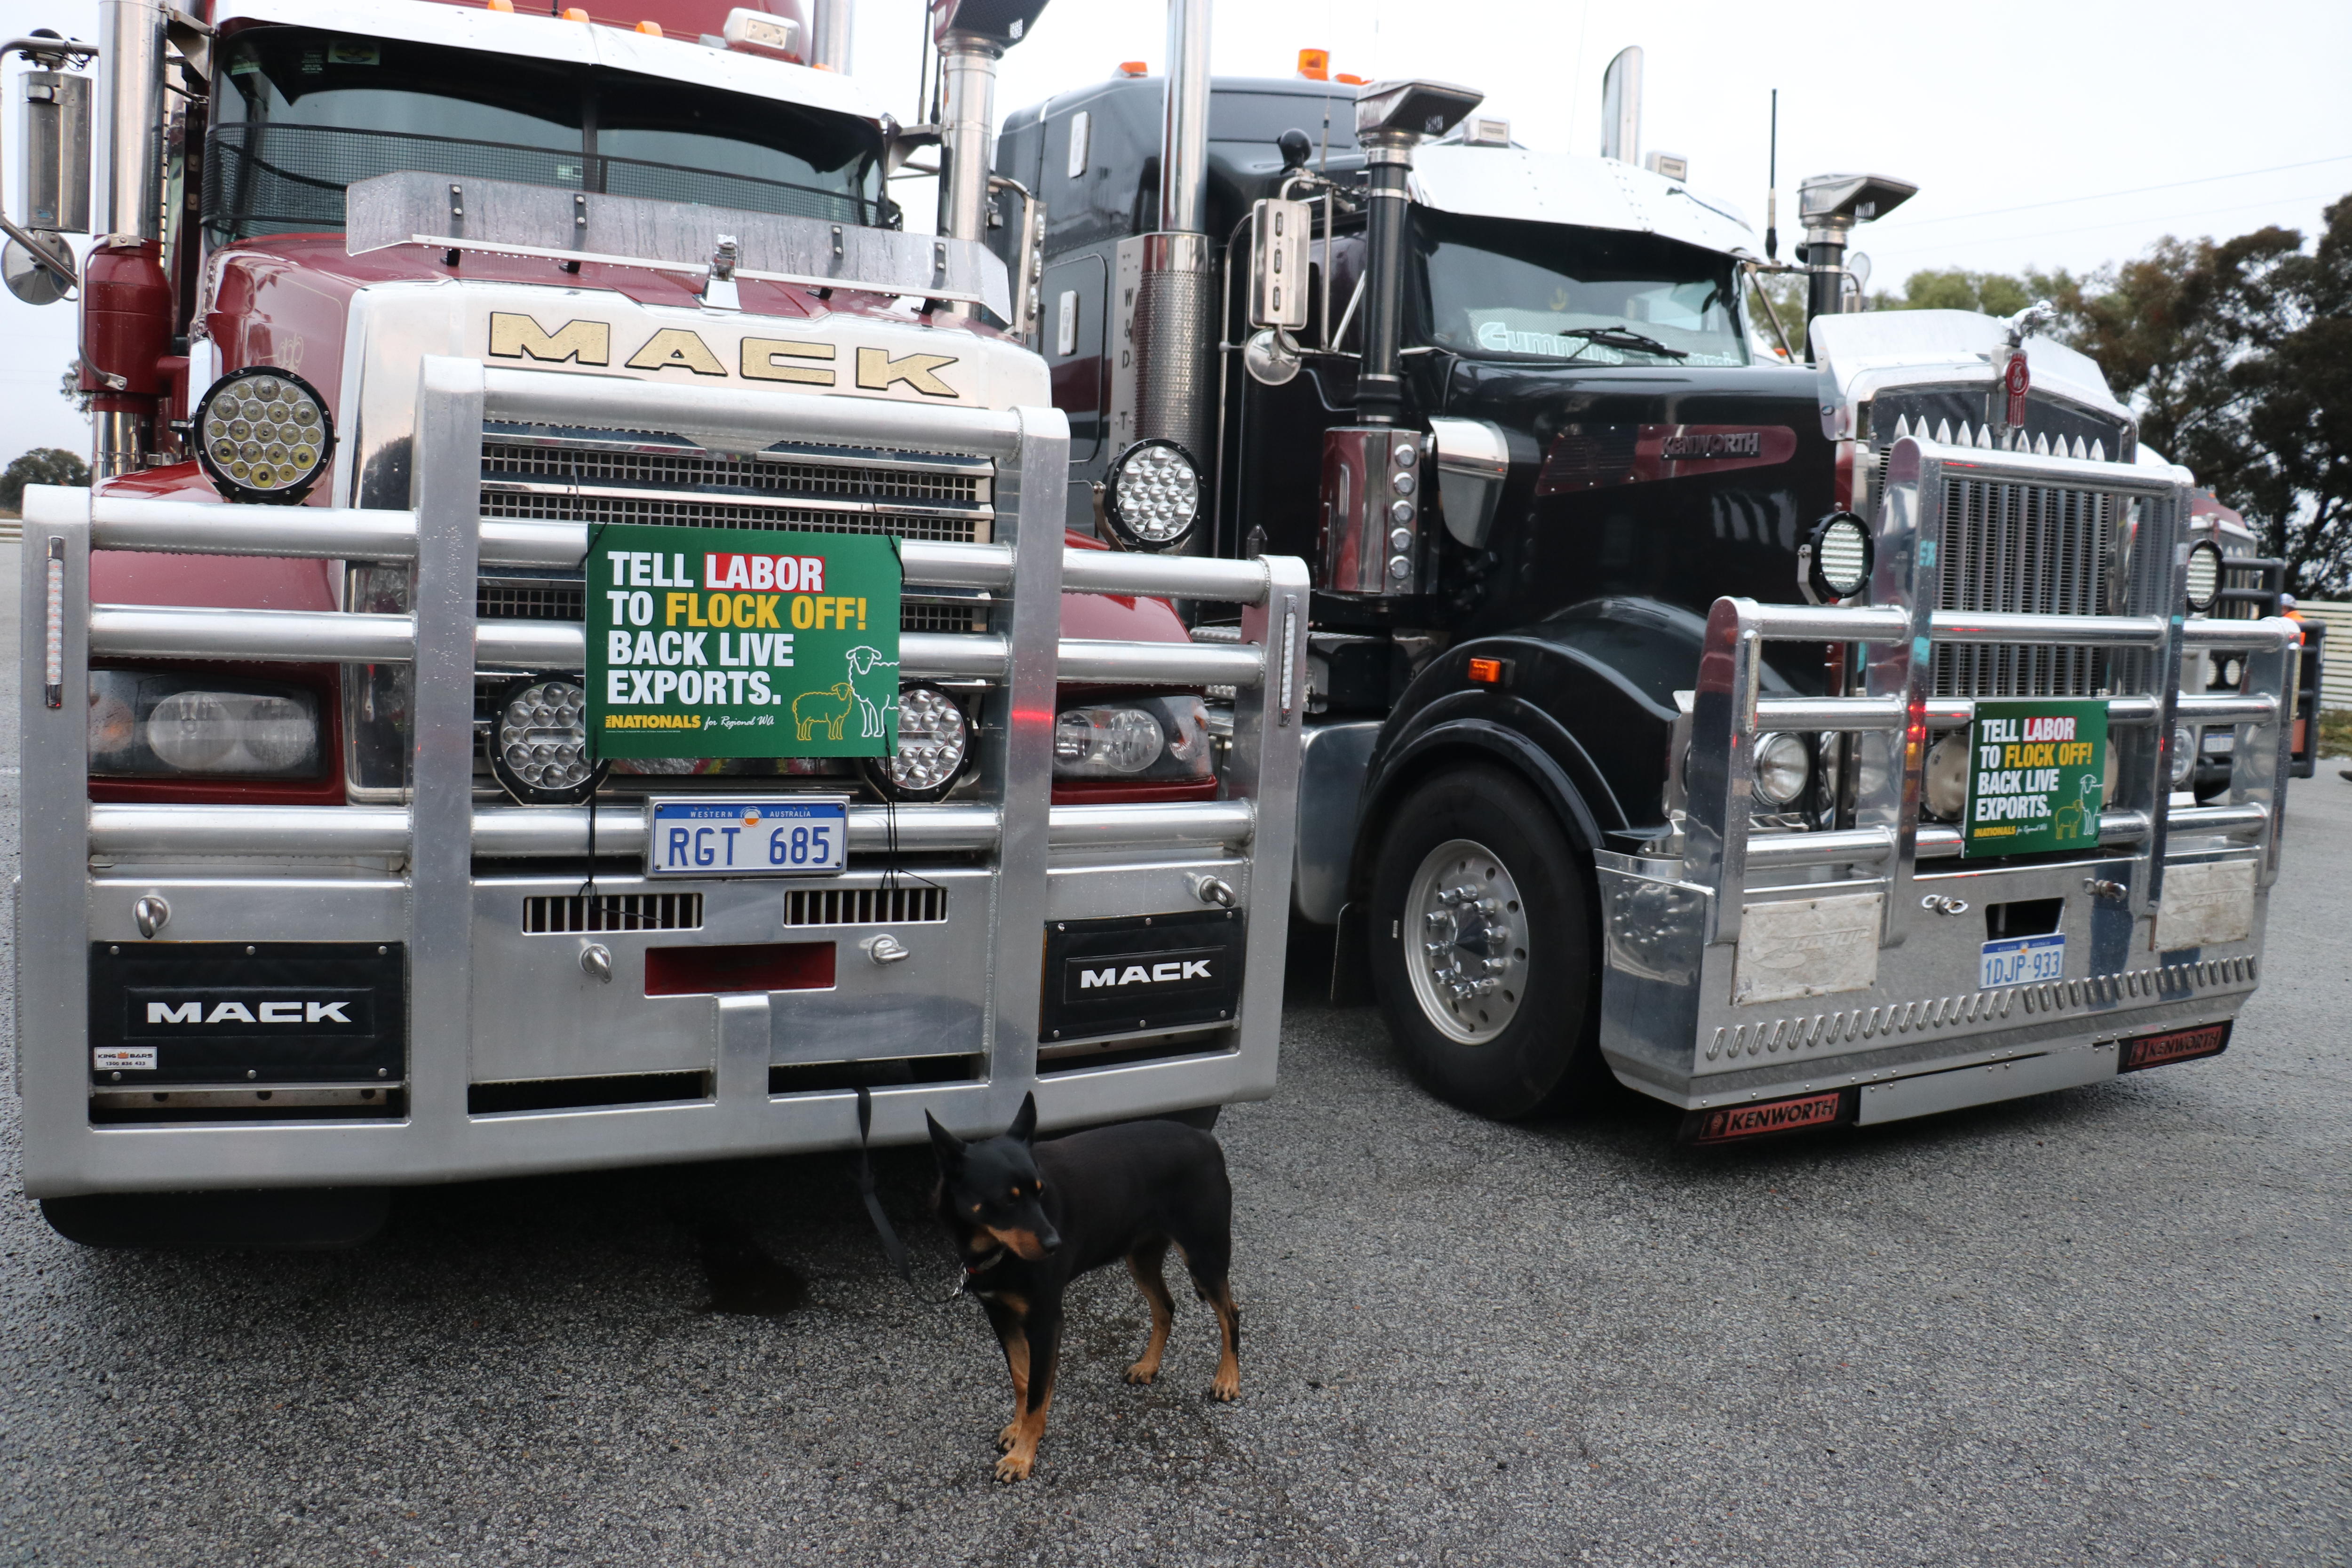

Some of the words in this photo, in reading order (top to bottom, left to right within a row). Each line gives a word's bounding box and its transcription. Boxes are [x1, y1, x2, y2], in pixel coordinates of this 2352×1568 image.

[489, 311, 959, 398] MACK
[1662, 433, 1759, 455] KENWORTH
[607, 551, 694, 588] TELL
[706, 554, 823, 591] LABOR
[607, 590, 653, 626] TO
[666, 592, 781, 629] FLOCK
[791, 595, 867, 630] OFF!
[608, 630, 708, 666] BACK
[720, 632, 794, 667] LIVE
[608, 670, 781, 705] EXPORTS.
[612, 715, 701, 728] NATIONALS
[704, 716, 717, 731] for
[721, 716, 756, 730] Regional
[757, 714, 774, 726] WA
[1981, 719, 2019, 742] TELL
[2022, 717, 2075, 741] LABOR
[1979, 745, 2001, 769] TO
[2004, 744, 2055, 768] FLOCK
[2058, 743, 2093, 766] OFF!
[1977, 770, 2022, 795] BACK
[2025, 769, 2060, 793] LIVE
[1975, 795, 2051, 821] EXPORTS.
[1976, 826, 2016, 837] NATIONALS
[668, 826, 741, 866] RGT
[769, 826, 830, 865] 685
[1081, 960, 1212, 988] MACK
[147, 1002, 352, 1023] MACK
[2148, 1031, 2219, 1057] KENWORTH
[1729, 1098, 1836, 1132] KENWORTH
